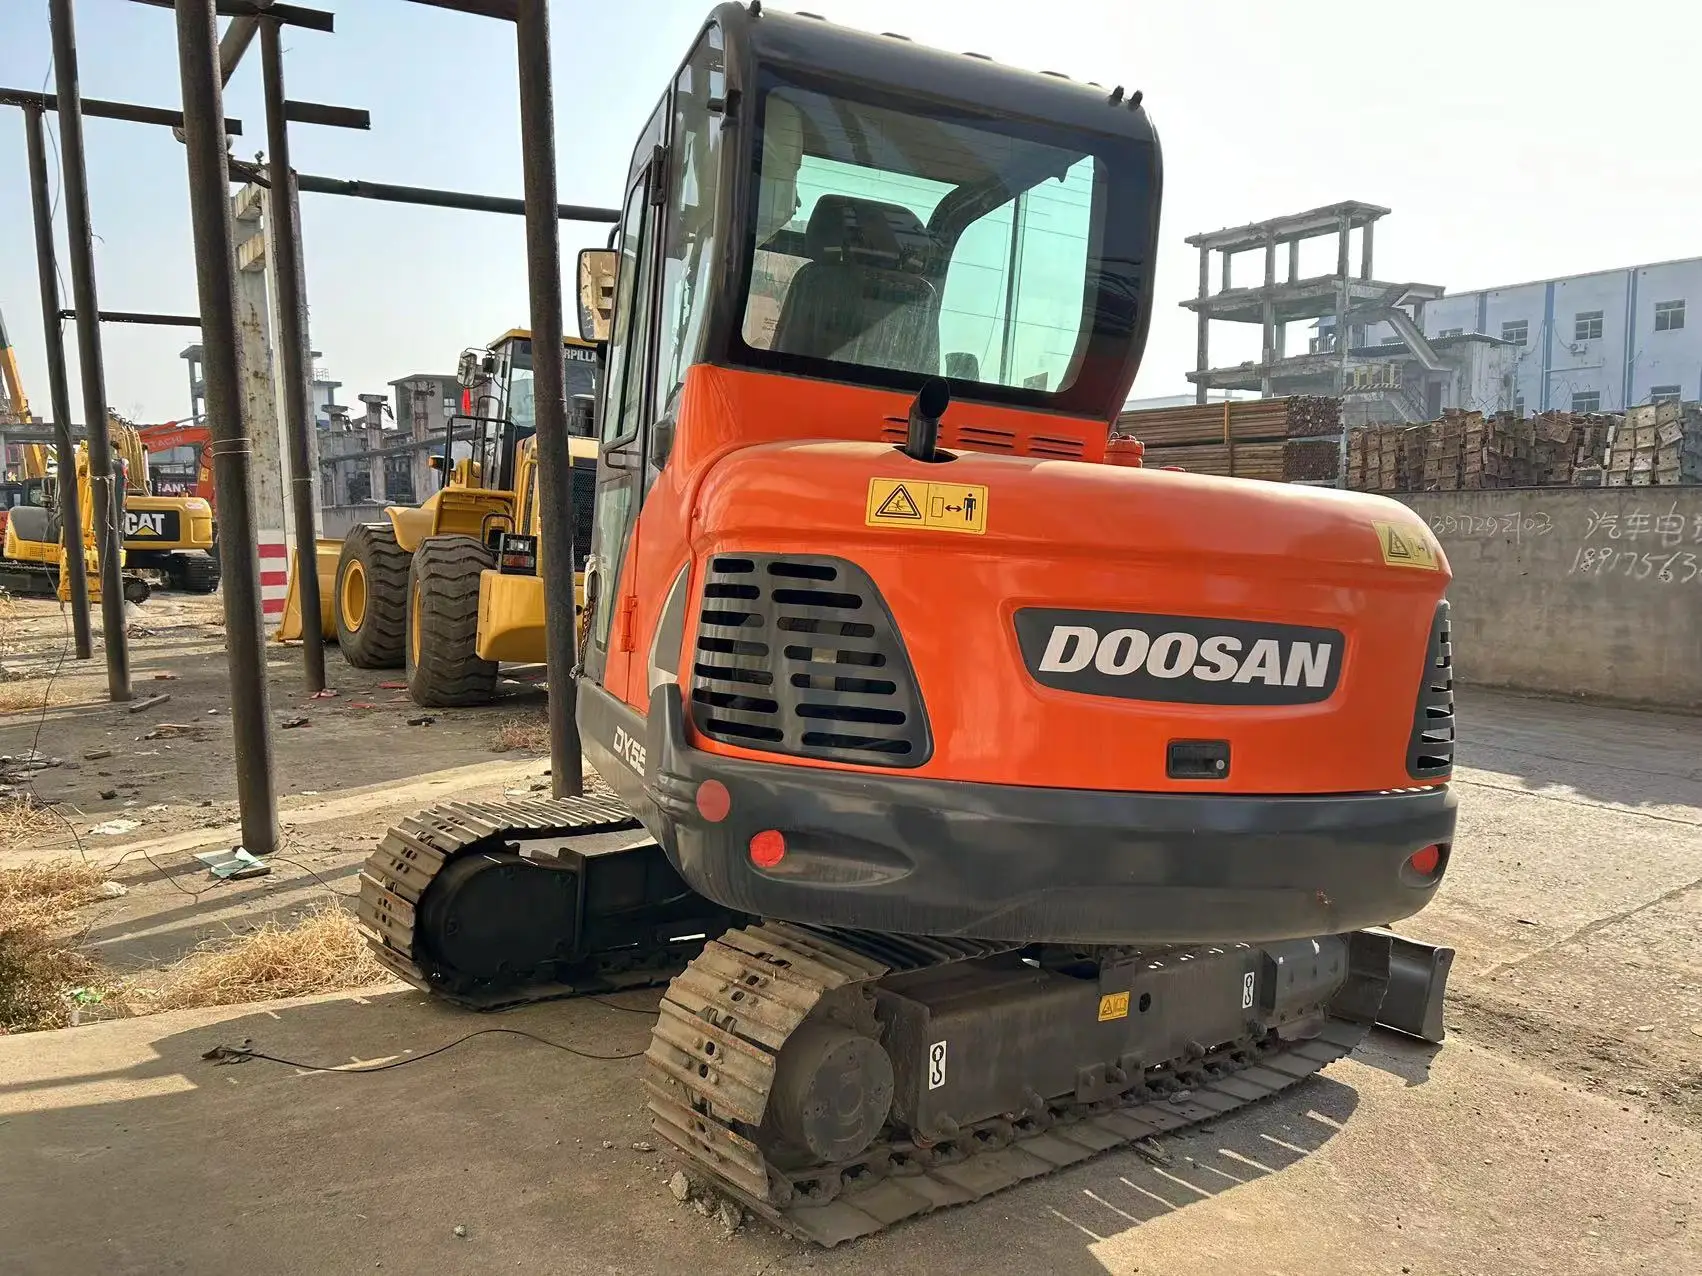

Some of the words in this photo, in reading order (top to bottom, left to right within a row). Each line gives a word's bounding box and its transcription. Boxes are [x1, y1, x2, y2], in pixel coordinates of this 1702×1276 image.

[564, 348, 597, 362] RPILLA
[125, 513, 165, 535] CAT
[1567, 547, 1702, 583] 18917563
[1038, 624, 1332, 688] DOOSAN
[613, 725, 647, 777] DX55
